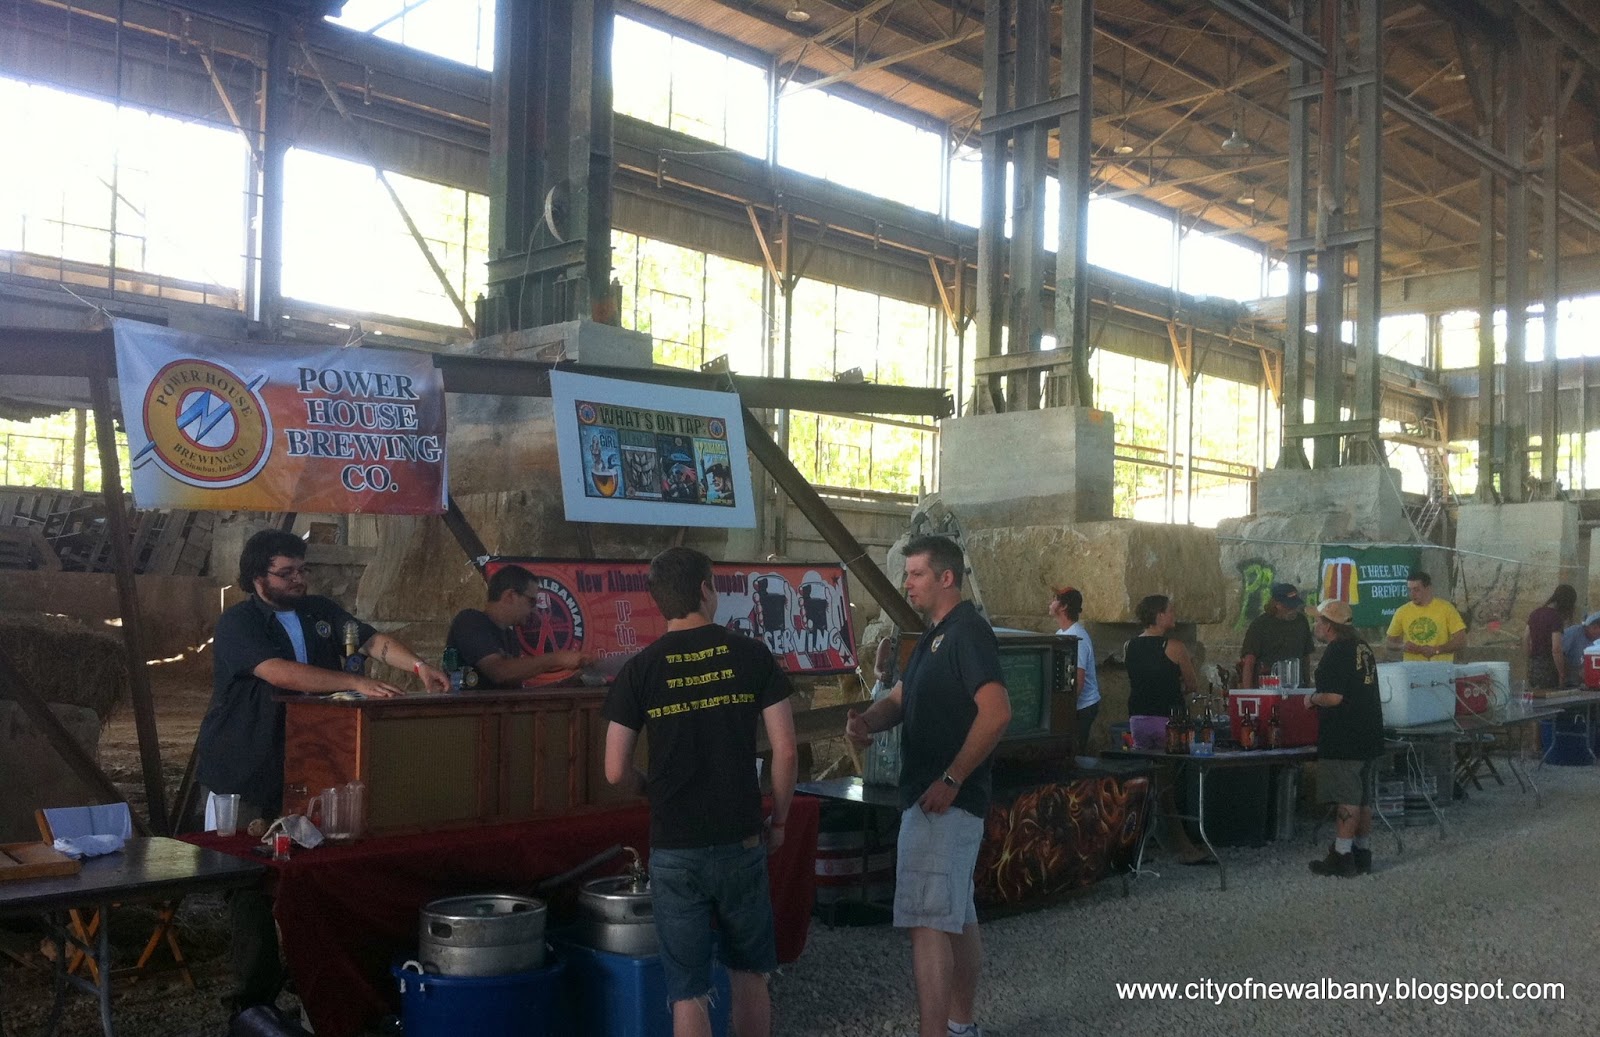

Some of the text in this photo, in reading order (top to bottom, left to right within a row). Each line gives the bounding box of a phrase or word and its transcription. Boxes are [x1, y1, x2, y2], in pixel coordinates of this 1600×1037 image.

[156, 369, 253, 418] POWER HOUSE
[297, 366, 419, 400] POWER
[303, 398, 418, 431] HOUSE
[656, 414, 675, 433] ON
[285, 428, 442, 463] BREWING
[599, 434, 618, 449] GIRL
[173, 443, 231, 465] BREWING
[341, 464, 399, 493] CO.
[576, 570, 603, 593] New
[1360, 564, 1391, 579] THREE
[615, 599, 632, 623] UP
[615, 623, 637, 647] the
[665, 653, 682, 664] WE
[684, 648, 714, 662] BREW
[666, 677, 684, 689] WE
[685, 671, 719, 687] DRINK
[647, 707, 662, 719] WE
[663, 702, 690, 716] SELL
[690, 695, 730, 711] WHAT'S
